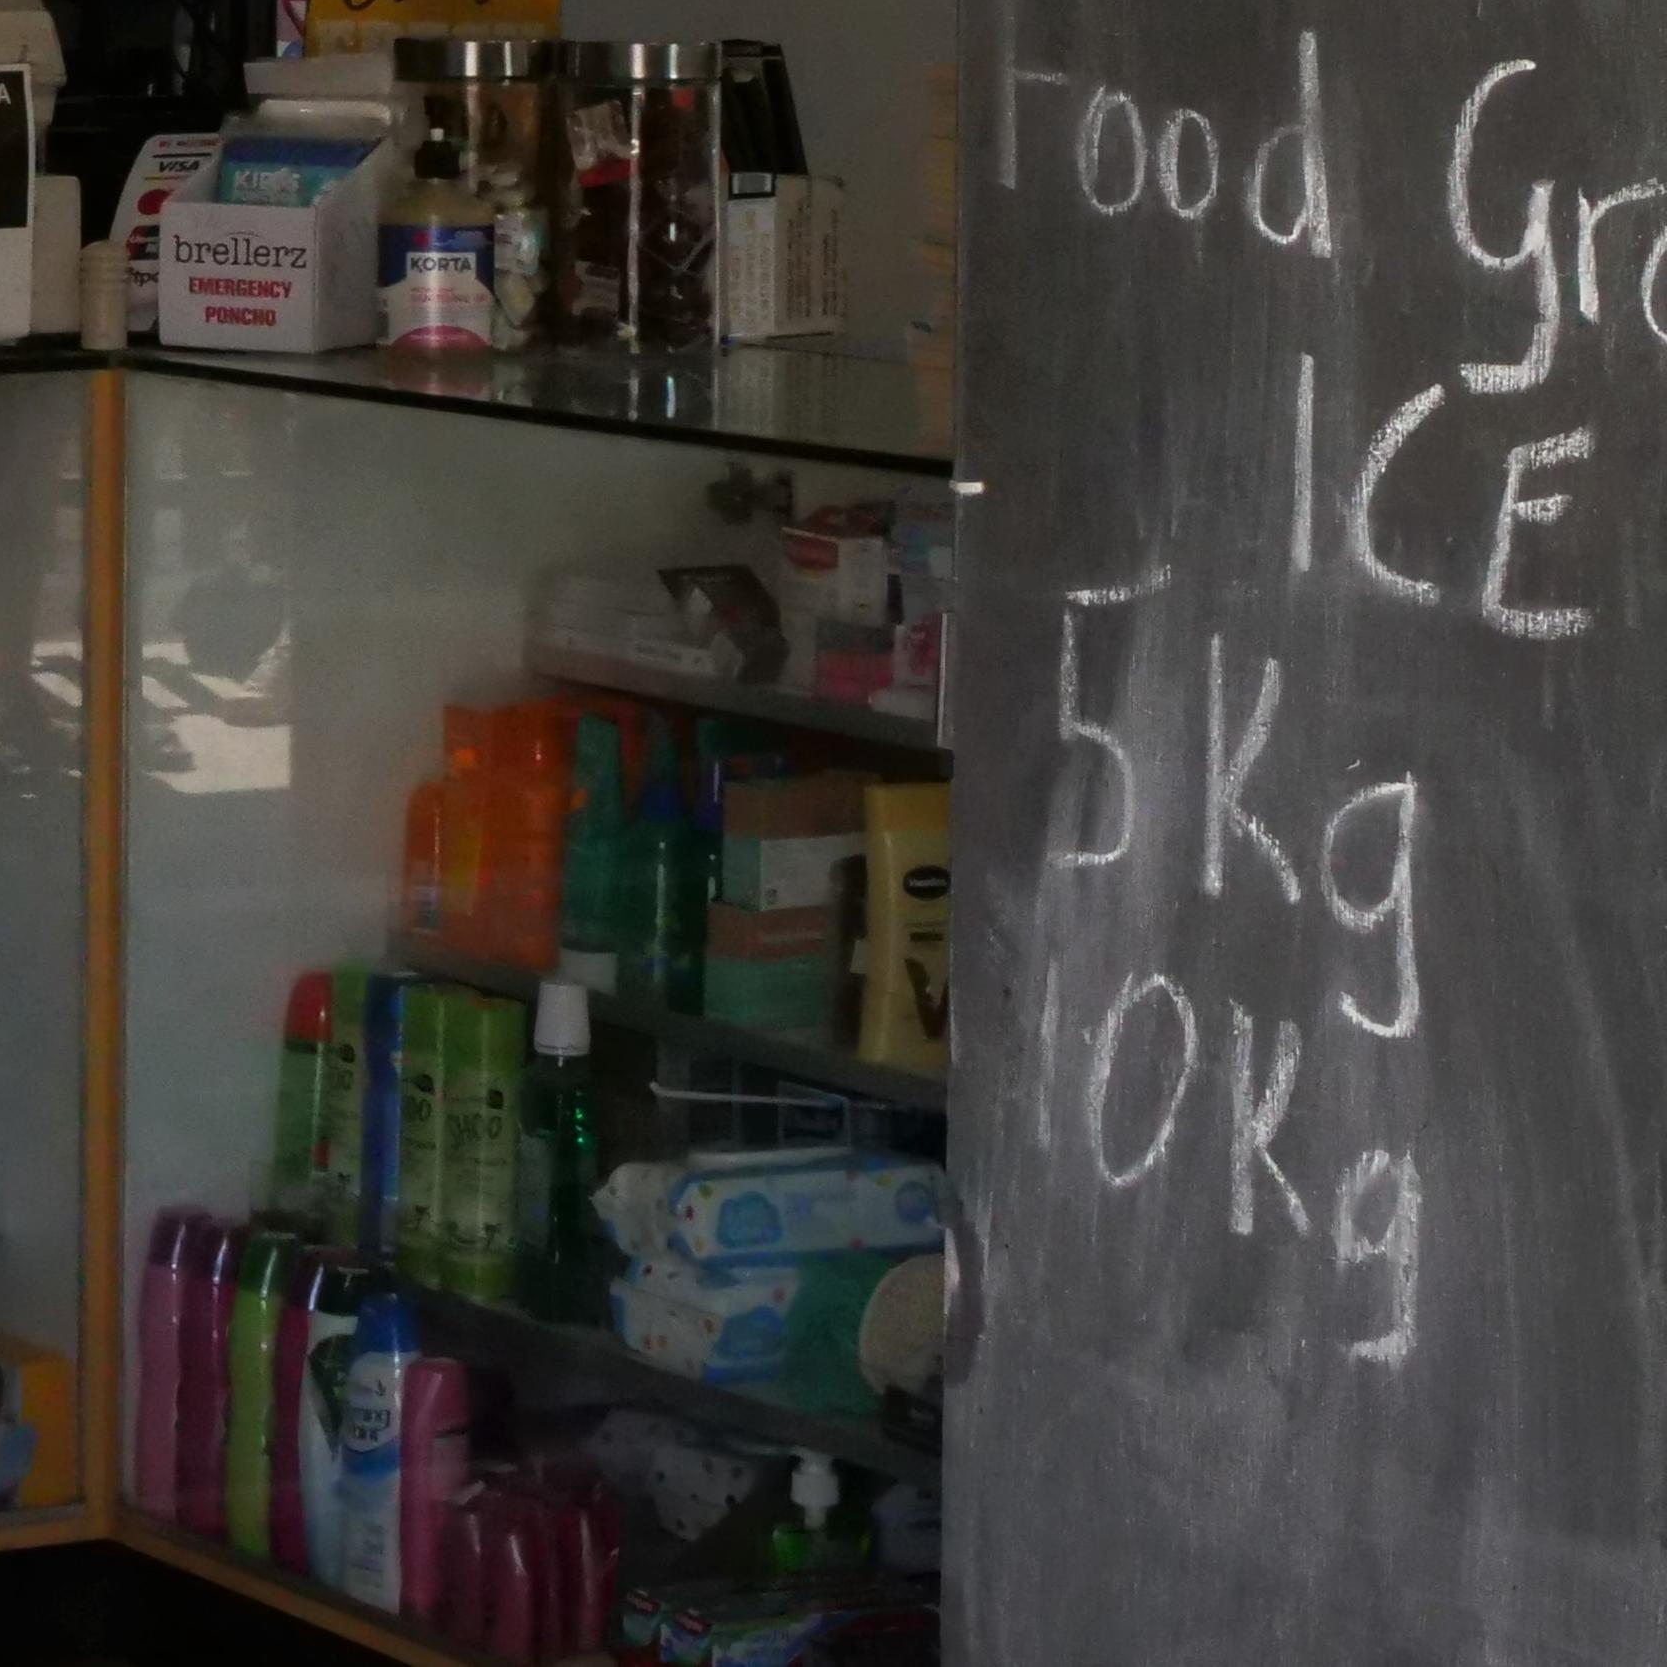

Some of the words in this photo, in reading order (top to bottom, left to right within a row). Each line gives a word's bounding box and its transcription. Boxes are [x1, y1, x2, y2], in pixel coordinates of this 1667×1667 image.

[158, 160, 200, 173] VISA
[173, 233, 308, 269] brellerz
[409, 256, 472, 273] KORTA
[188, 276, 293, 300] EMERGENCY
[204, 305, 277, 327] PONCHO
[1289, 352, 1596, 638] ICE
